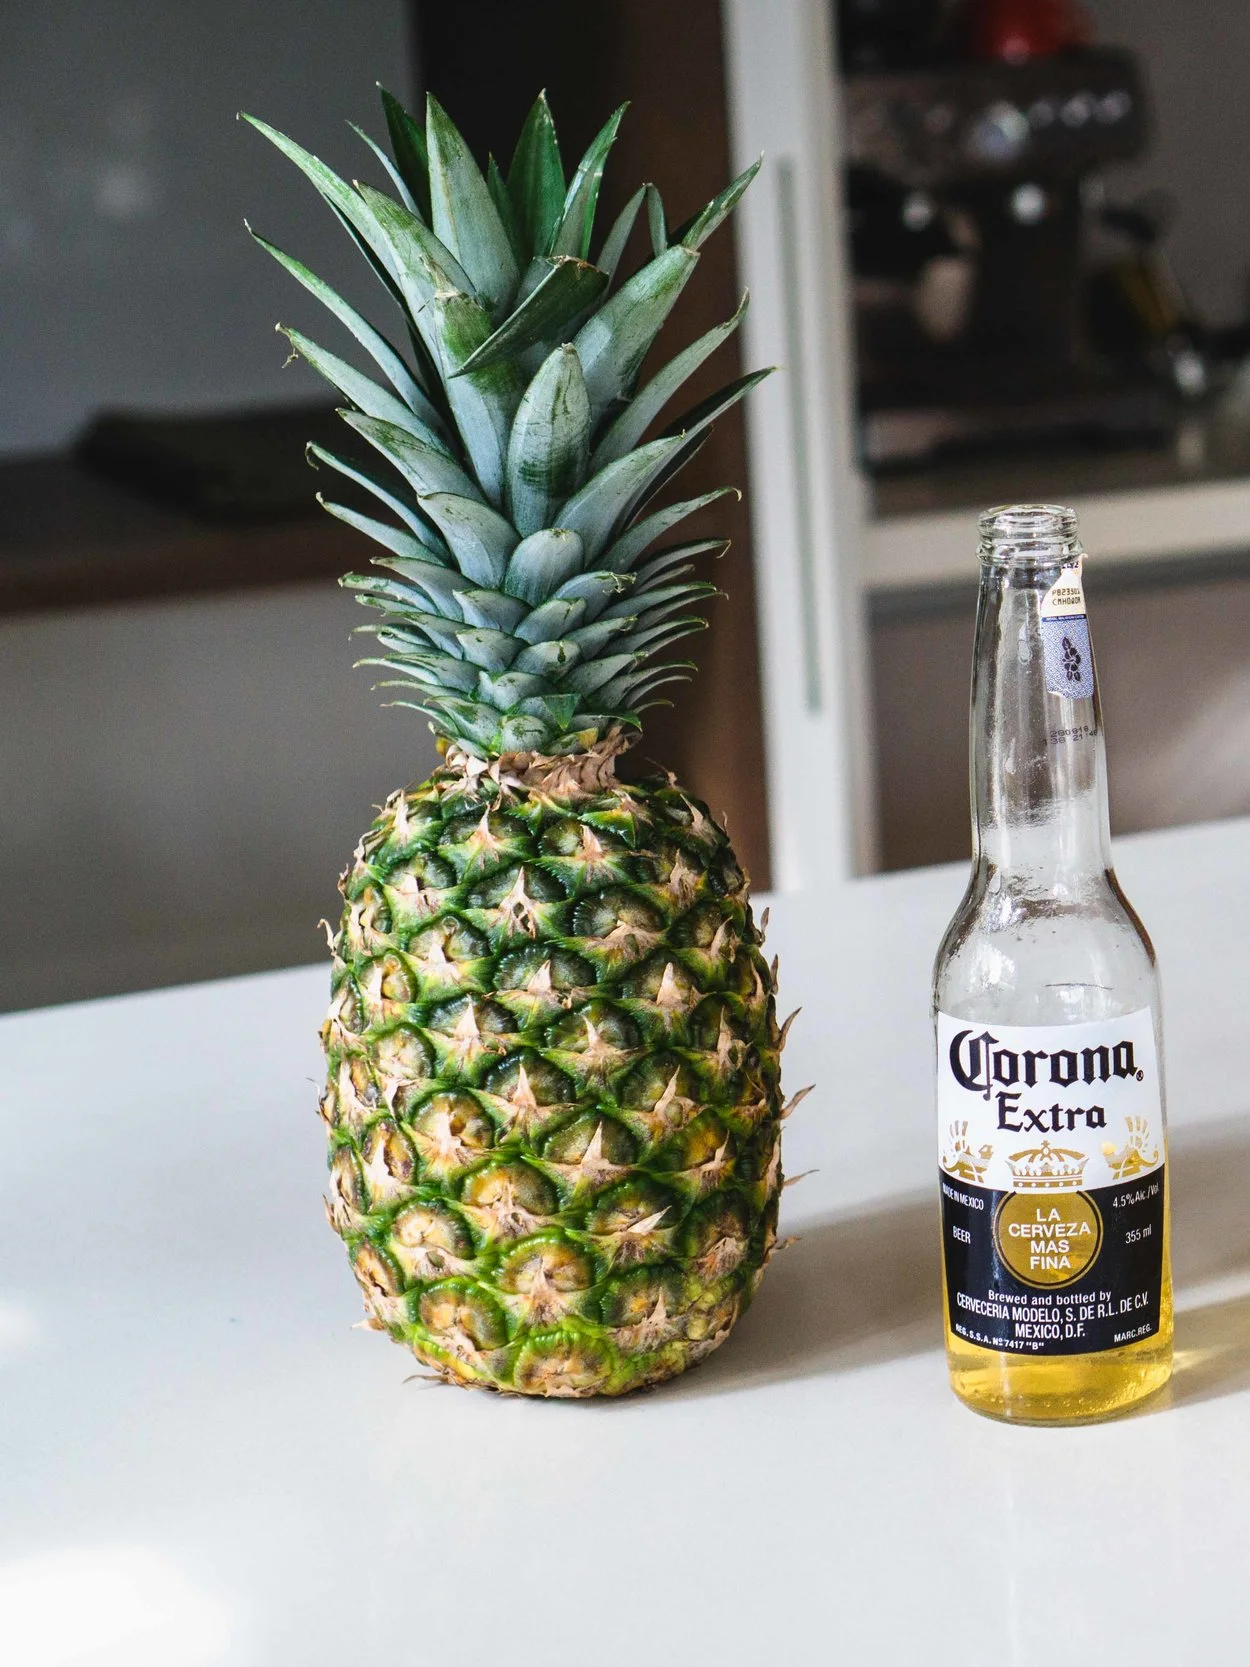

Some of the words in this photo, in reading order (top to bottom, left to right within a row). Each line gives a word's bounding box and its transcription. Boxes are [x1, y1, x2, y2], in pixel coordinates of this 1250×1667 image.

[995, 1091, 1107, 1133] Extra
[960, 1193, 984, 1210] MEXICO
[1036, 1208, 1061, 1222] LA
[952, 1225, 971, 1244] BEER
[1008, 1222, 1091, 1238] CERVEZA
[1125, 1228, 1141, 1244] 355
[1142, 1224, 1152, 1238] ml
[1030, 1240, 1070, 1254] MAS
[1030, 1256, 1071, 1270] FINA
[988, 1289, 1027, 1304] Brewed
[1031, 1294, 1052, 1306] and
[1056, 1292, 1096, 1305] bottled
[1100, 1290, 1112, 1302] by
[956, 1292, 1010, 1320] CERVECERIA
[1012, 1306, 1064, 1324] MODELO,
[1065, 1307, 1076, 1322] S.
[1080, 1306, 1094, 1320] DE
[1098, 1302, 1118, 1318] R.L.
[1120, 1296, 1132, 1314] DE
[1134, 1291, 1149, 1309] C.V.
[1015, 1322, 1064, 1340] MEXICO,
[1065, 1322, 1086, 1338] D.F.
[1004, 1340, 1024, 1349] 7417
